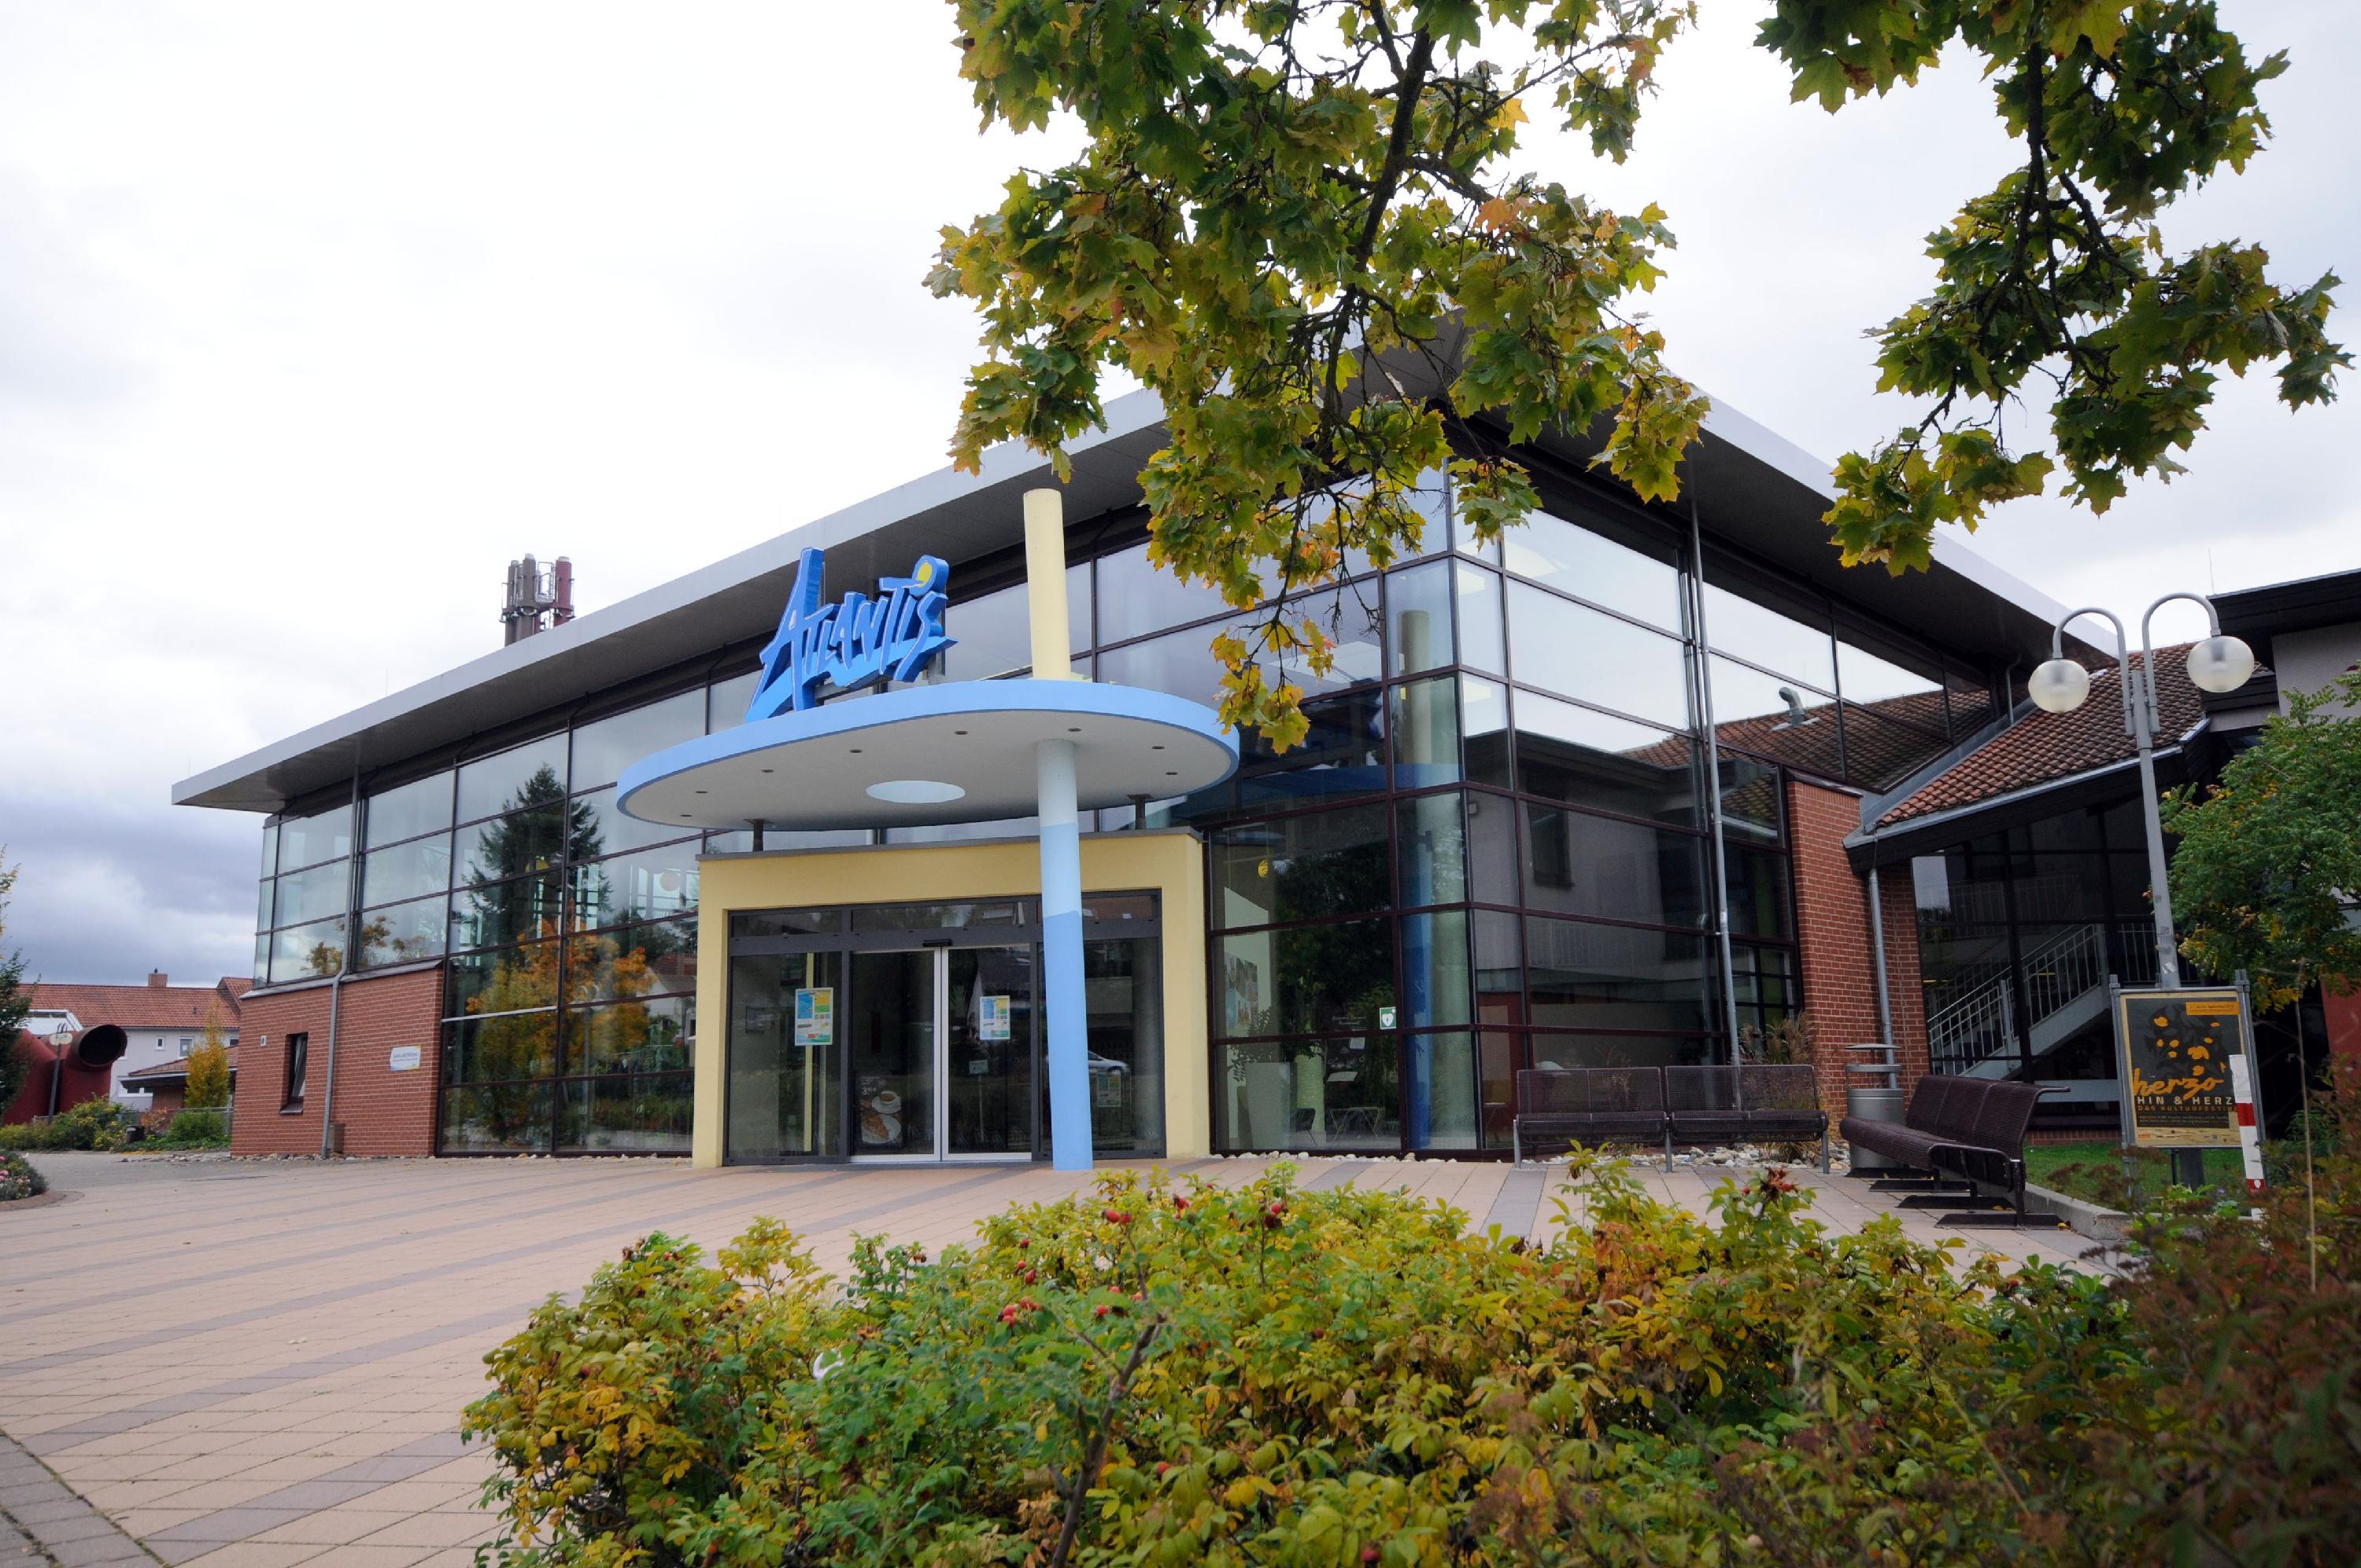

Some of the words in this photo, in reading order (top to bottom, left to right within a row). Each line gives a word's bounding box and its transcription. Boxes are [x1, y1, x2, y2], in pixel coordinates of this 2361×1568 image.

[2133, 1068, 2224, 1101] herzo
[2137, 1096, 2164, 1105] HIN
[2174, 1096, 2182, 1105] &
[2193, 1096, 2233, 1105] HERZ
